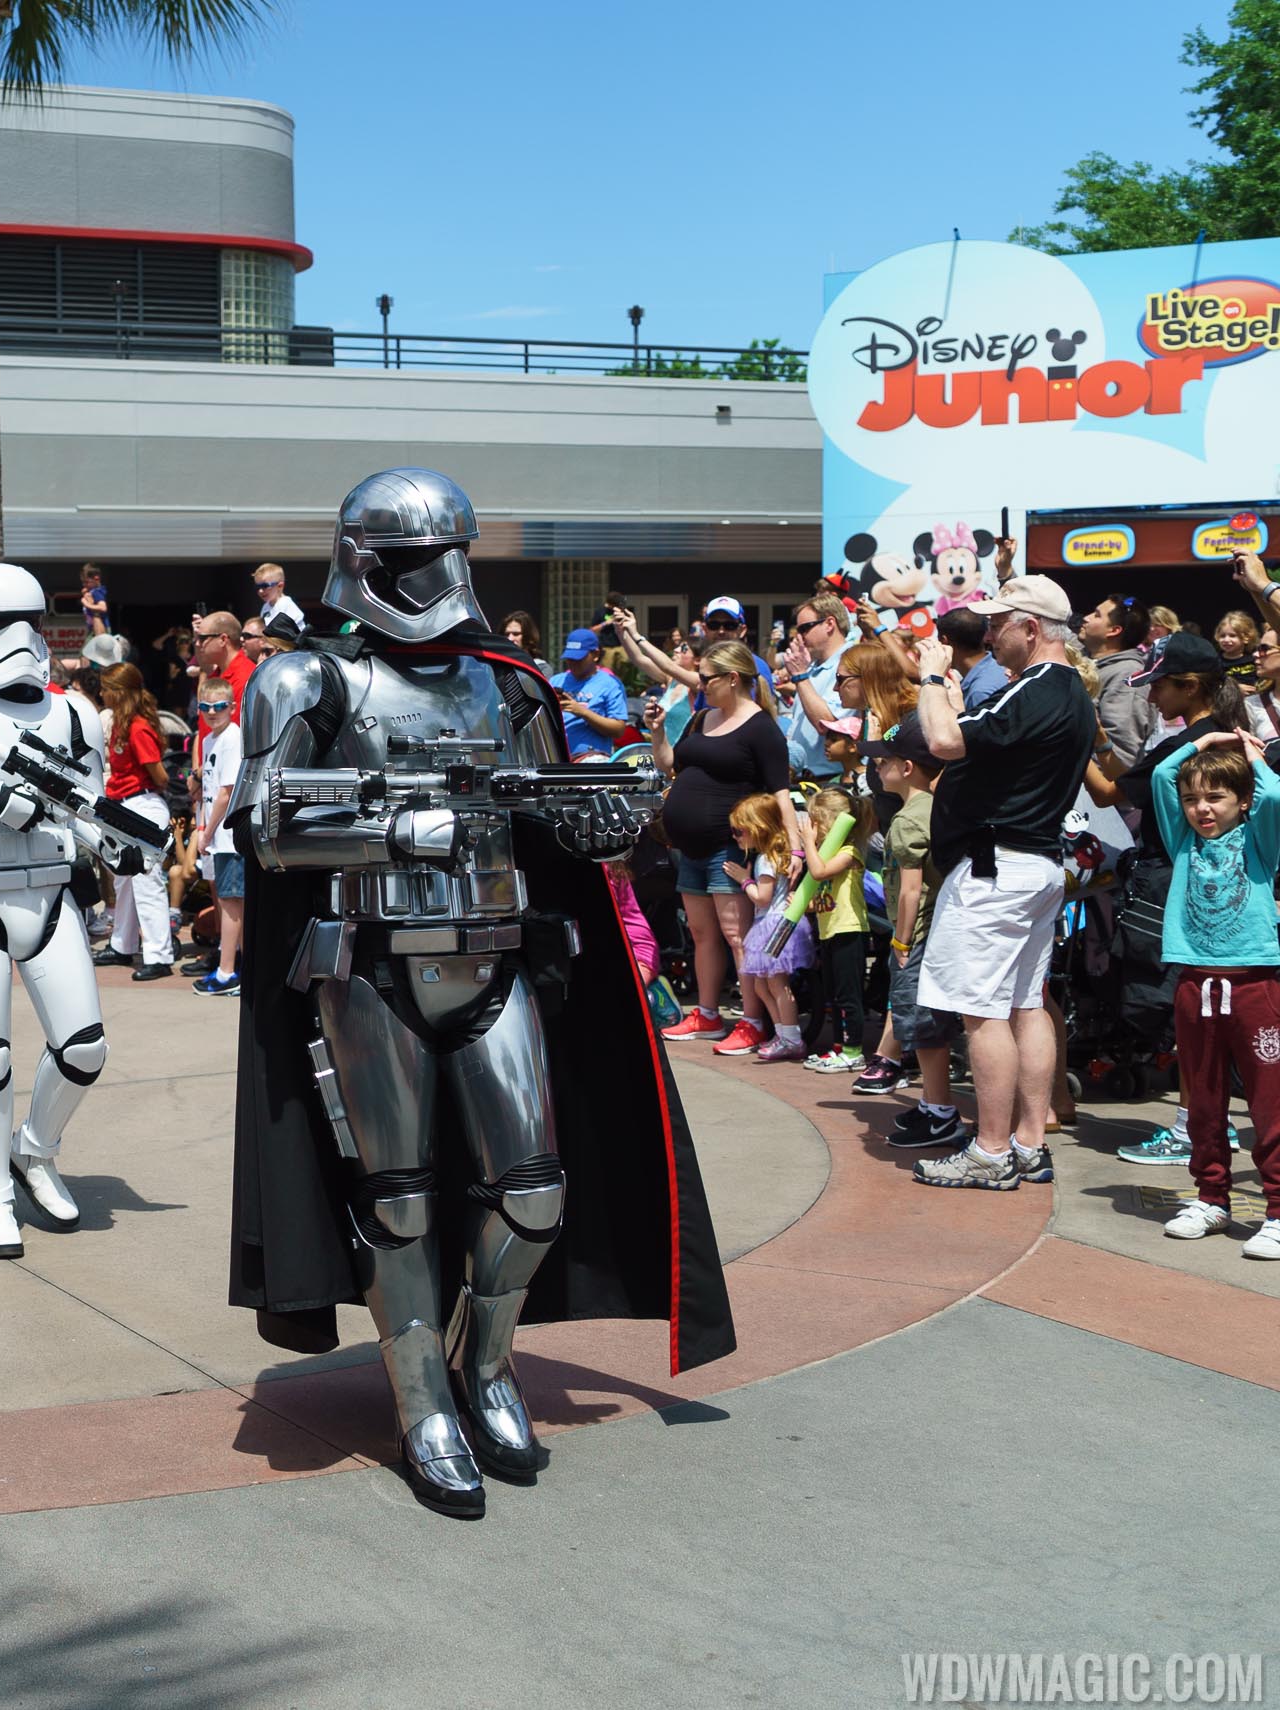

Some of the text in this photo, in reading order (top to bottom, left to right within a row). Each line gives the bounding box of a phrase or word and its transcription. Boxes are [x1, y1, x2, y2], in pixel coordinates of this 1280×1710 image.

[1150, 291, 1240, 321] Live on
[1162, 307, 1280, 347] Stage!
